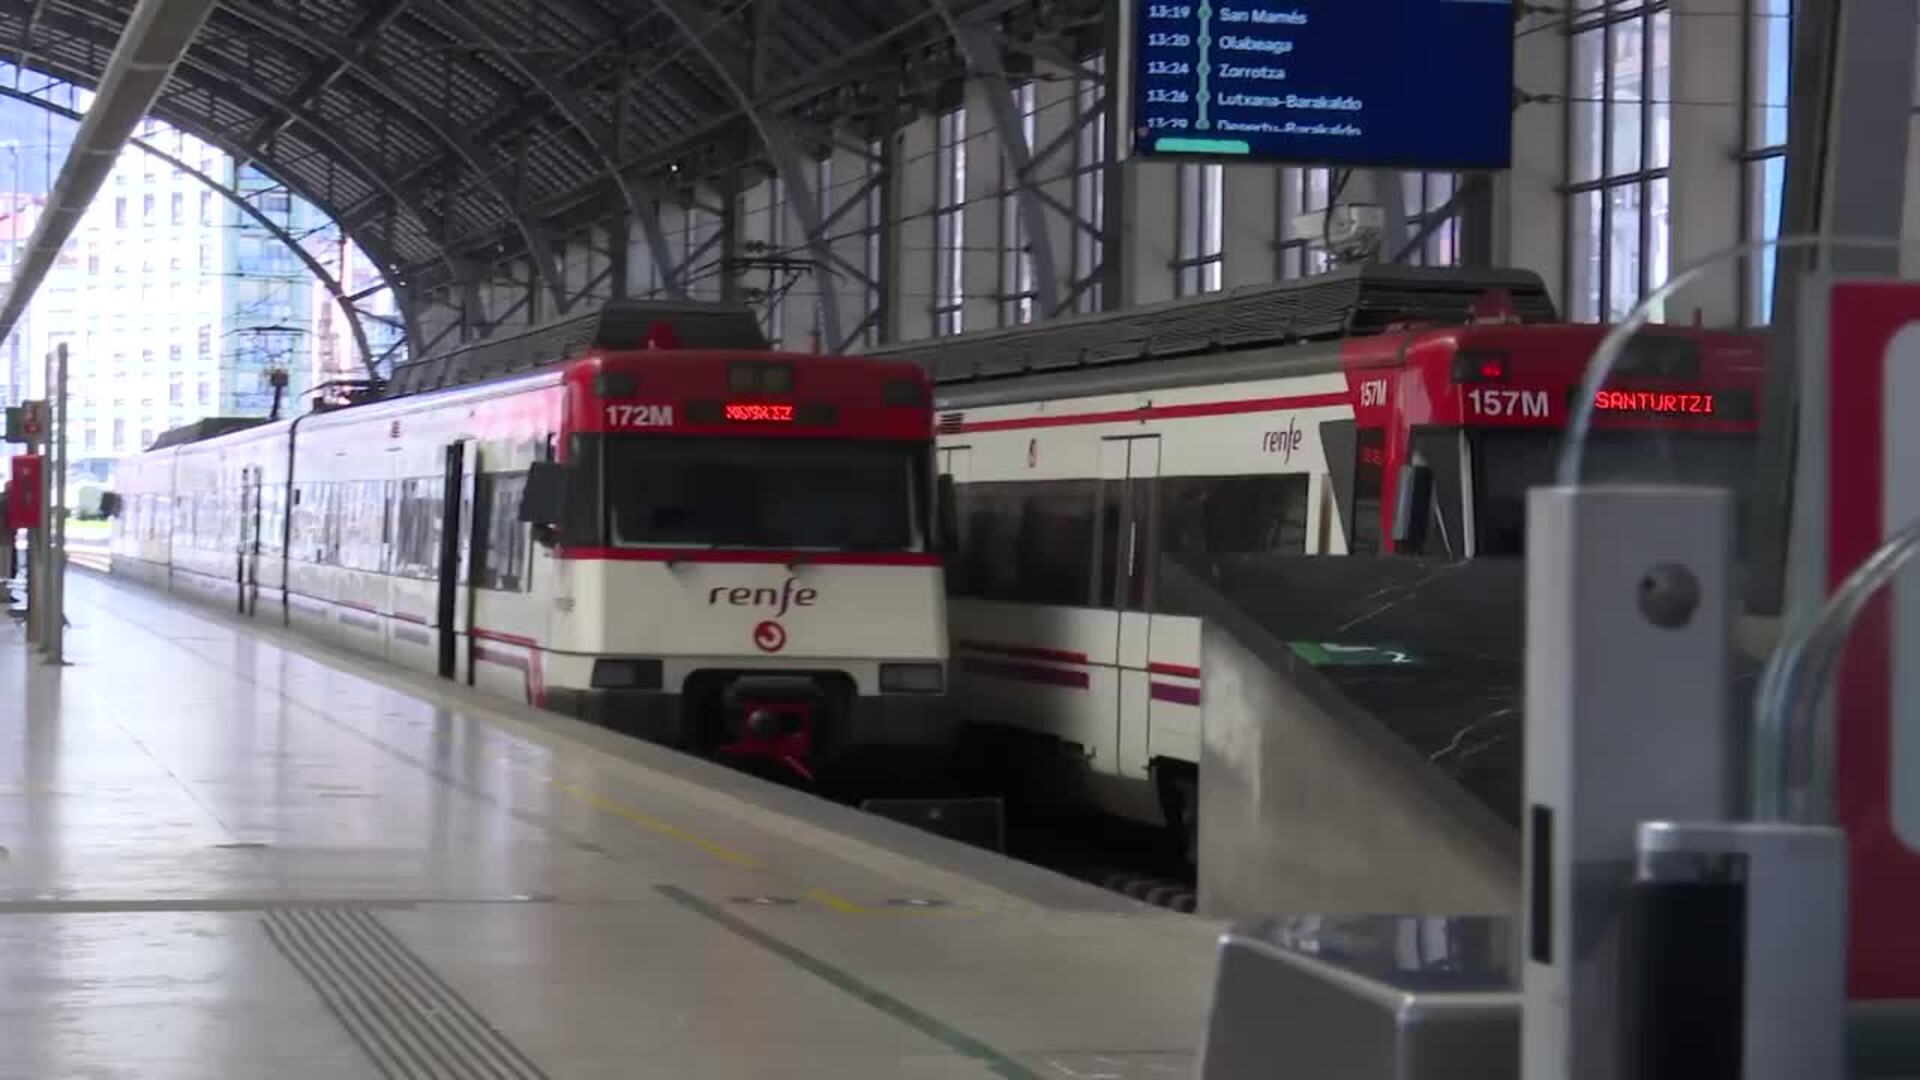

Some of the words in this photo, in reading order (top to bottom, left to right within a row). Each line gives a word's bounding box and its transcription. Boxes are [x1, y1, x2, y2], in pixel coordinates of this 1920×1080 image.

[1220, 8, 1249, 21] San
[1252, 10, 1307, 24] Mamés
[1219, 36, 1292, 54] Olabeaga
[1220, 64, 1285, 79] Zorrotza
[1218, 93, 1362, 110] Lutxana-Barakaldo
[1360, 379, 1388, 408] 157M
[1468, 389, 1550, 418] 157M
[1594, 390, 1714, 413] SANTURTZI
[606, 405, 673, 426] 172M
[1262, 416, 1303, 465] renfe
[708, 577, 818, 617] renfe
